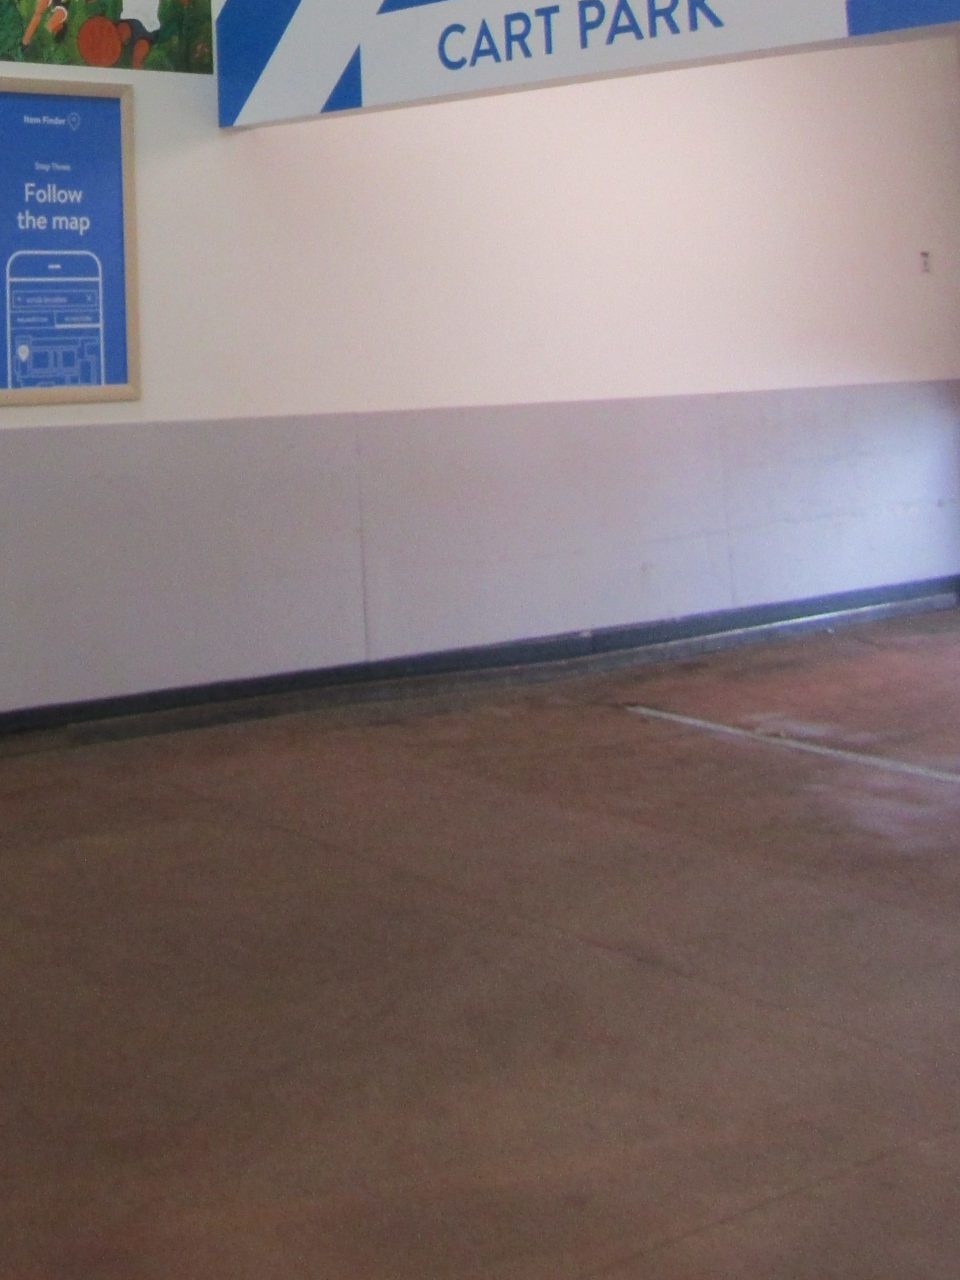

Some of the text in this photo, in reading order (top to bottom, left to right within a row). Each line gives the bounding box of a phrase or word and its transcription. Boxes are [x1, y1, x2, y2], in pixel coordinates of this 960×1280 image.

[437, 4, 560, 71] CART
[23, 114, 66, 126] Item Finder
[23, 182, 83, 204] Follow
[16, 209, 91, 236] the map
